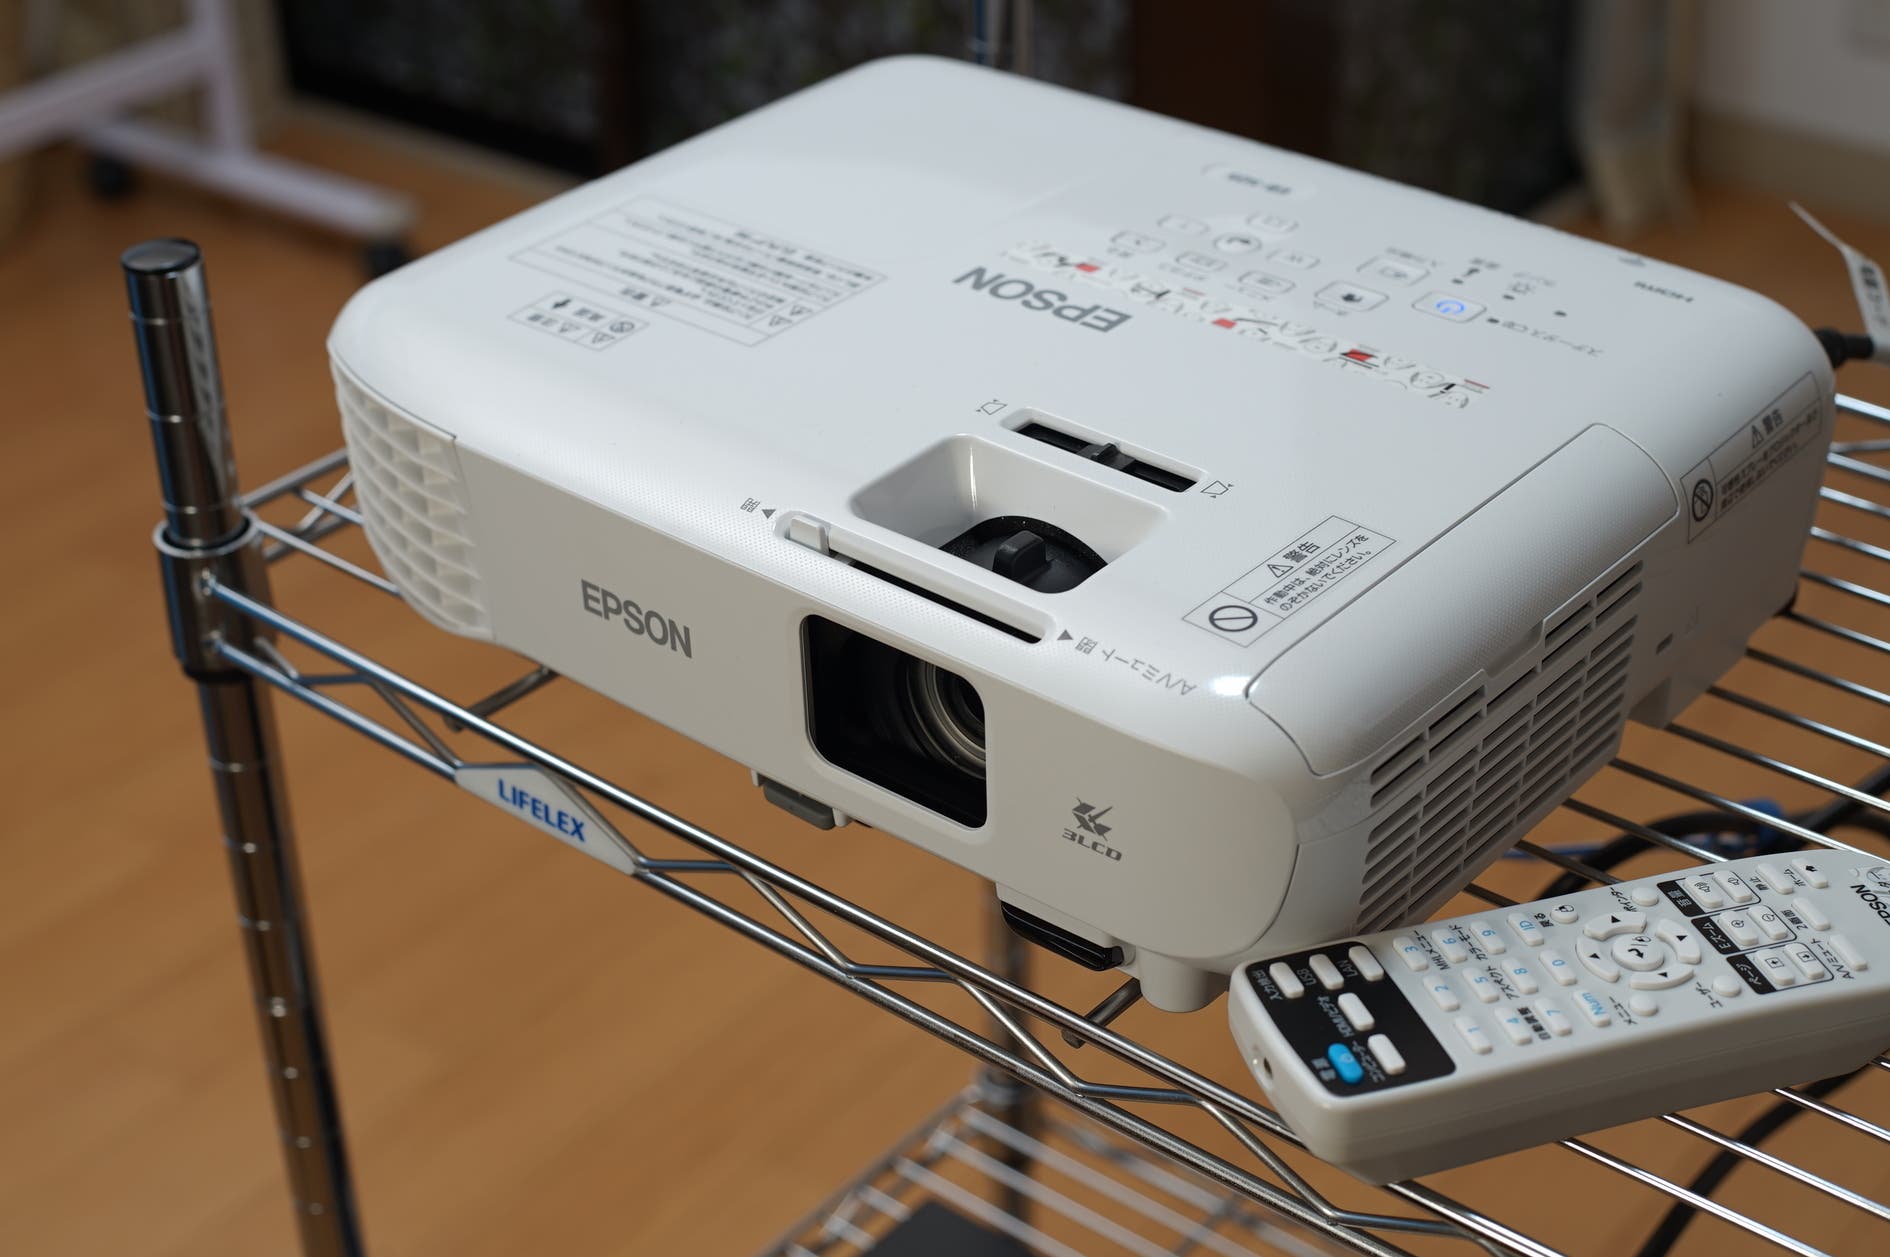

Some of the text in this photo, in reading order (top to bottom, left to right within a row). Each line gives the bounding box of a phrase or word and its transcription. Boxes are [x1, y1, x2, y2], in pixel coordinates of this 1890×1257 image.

[953, 266, 1132, 333] EPSON
[1283, 540, 1321, 563] 警告
[1263, 533, 1369, 606] 作動中は、絶対にレンズを
[1279, 550, 1372, 612] のぞかないでください。
[581, 579, 693, 659] EPSON
[498, 778, 585, 842] LIFELEX
[1062, 828, 1123, 862] 3LCD
[1519, 920, 1535, 931] ID
[1534, 912, 1554, 928] 戻る
[1443, 937, 1457, 945] 6
[1449, 924, 1488, 961] カラーモード
[1482, 929, 1496, 937] 9
[1404, 945, 1418, 953] 3
[1414, 930, 1450, 970] MHLメニュー
[1811, 938, 1854, 980] A/Vミュート
[1337, 959, 1358, 978] LAN
[1513, 967, 1528, 975] 8
[1552, 959, 1565, 967] 0
[1736, 963, 1762, 985] ページ
[1297, 968, 1317, 986] USB
[1434, 984, 1449, 992] 2
[1474, 976, 1488, 984] 5
[1487, 965, 1519, 1000] アスペクト
[1582, 992, 1608, 1016] Num
[1609, 996, 1638, 1026] メニュー
